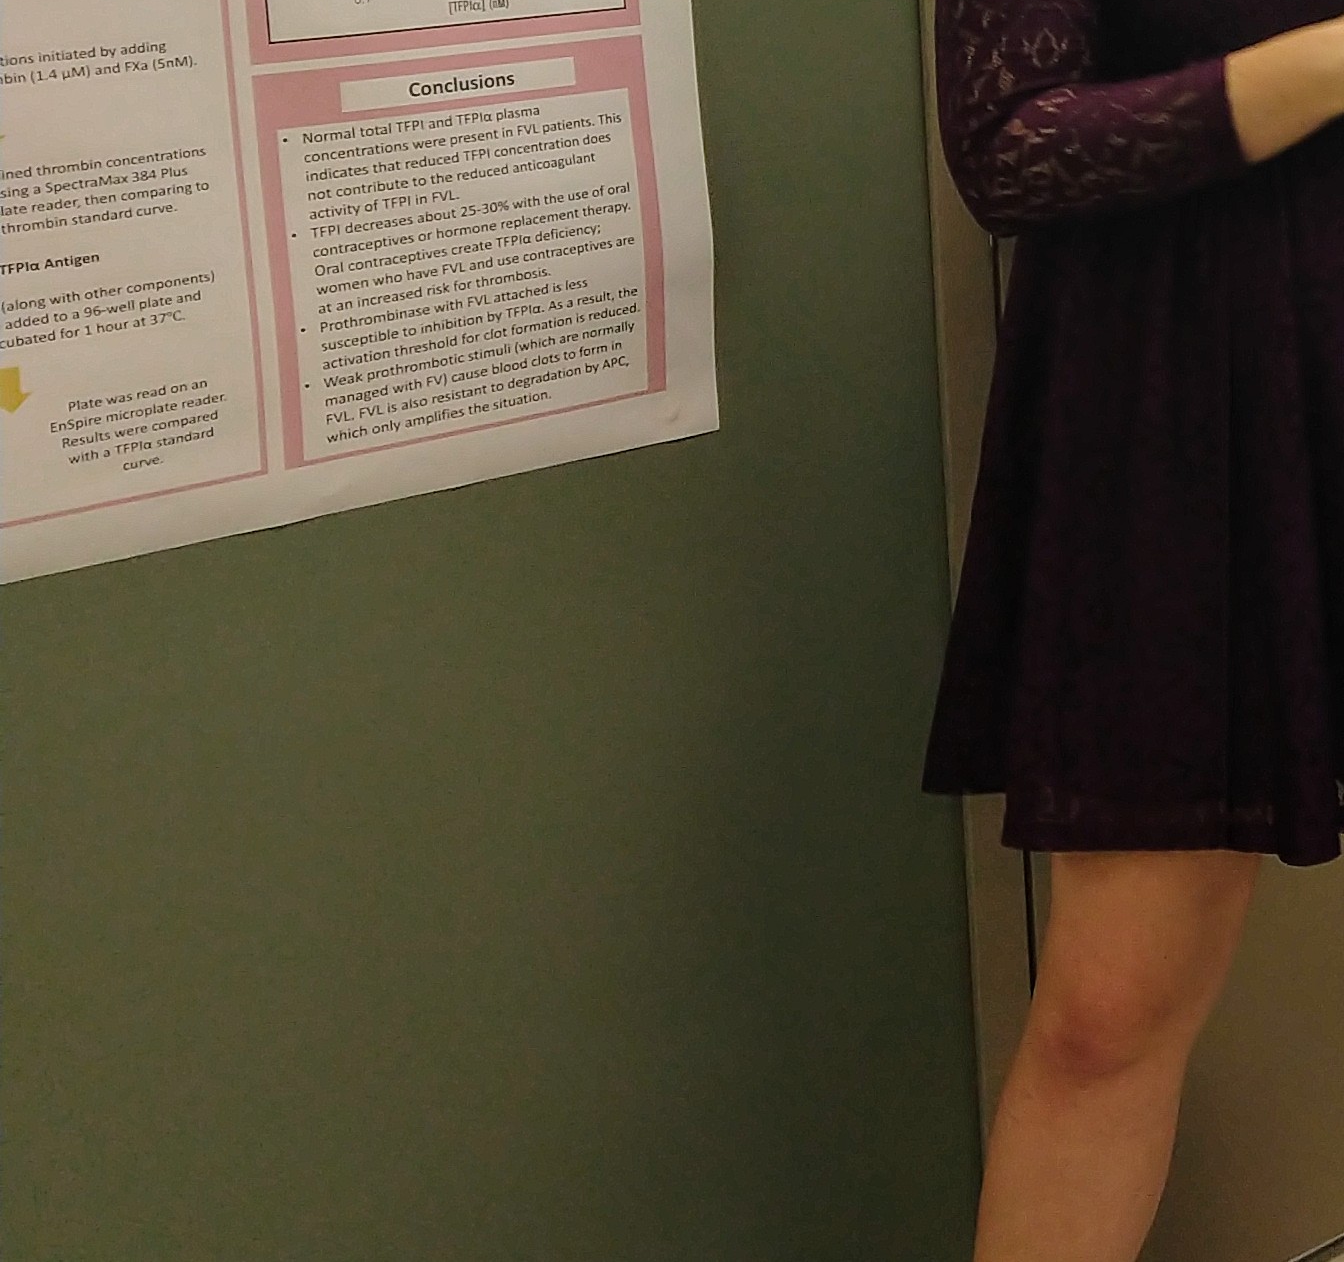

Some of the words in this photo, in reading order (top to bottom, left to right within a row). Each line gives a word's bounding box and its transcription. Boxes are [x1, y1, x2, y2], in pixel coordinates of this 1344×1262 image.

[408, 74, 514, 97] Conclusions
[302, 126, 355, 144] Normal
[359, 122, 391, 137] total
[395, 119, 424, 133] TFPI
[428, 115, 453, 129] and
[495, 107, 539, 122] plasma
[304, 142, 409, 163] concentrations
[412, 137, 446, 149] were
[450, 129, 499, 147] present
[501, 127, 513, 137] in
[516, 123, 539, 136] FVL
[542, 118, 595, 135] patients.
[597, 112, 621, 125] This
[326, 425, 367, 443] which
[371, 419, 400, 434] only
[404, 408, 464, 428] amplifies
[468, 402, 489, 415] the
[492, 391, 551, 410] situation.
